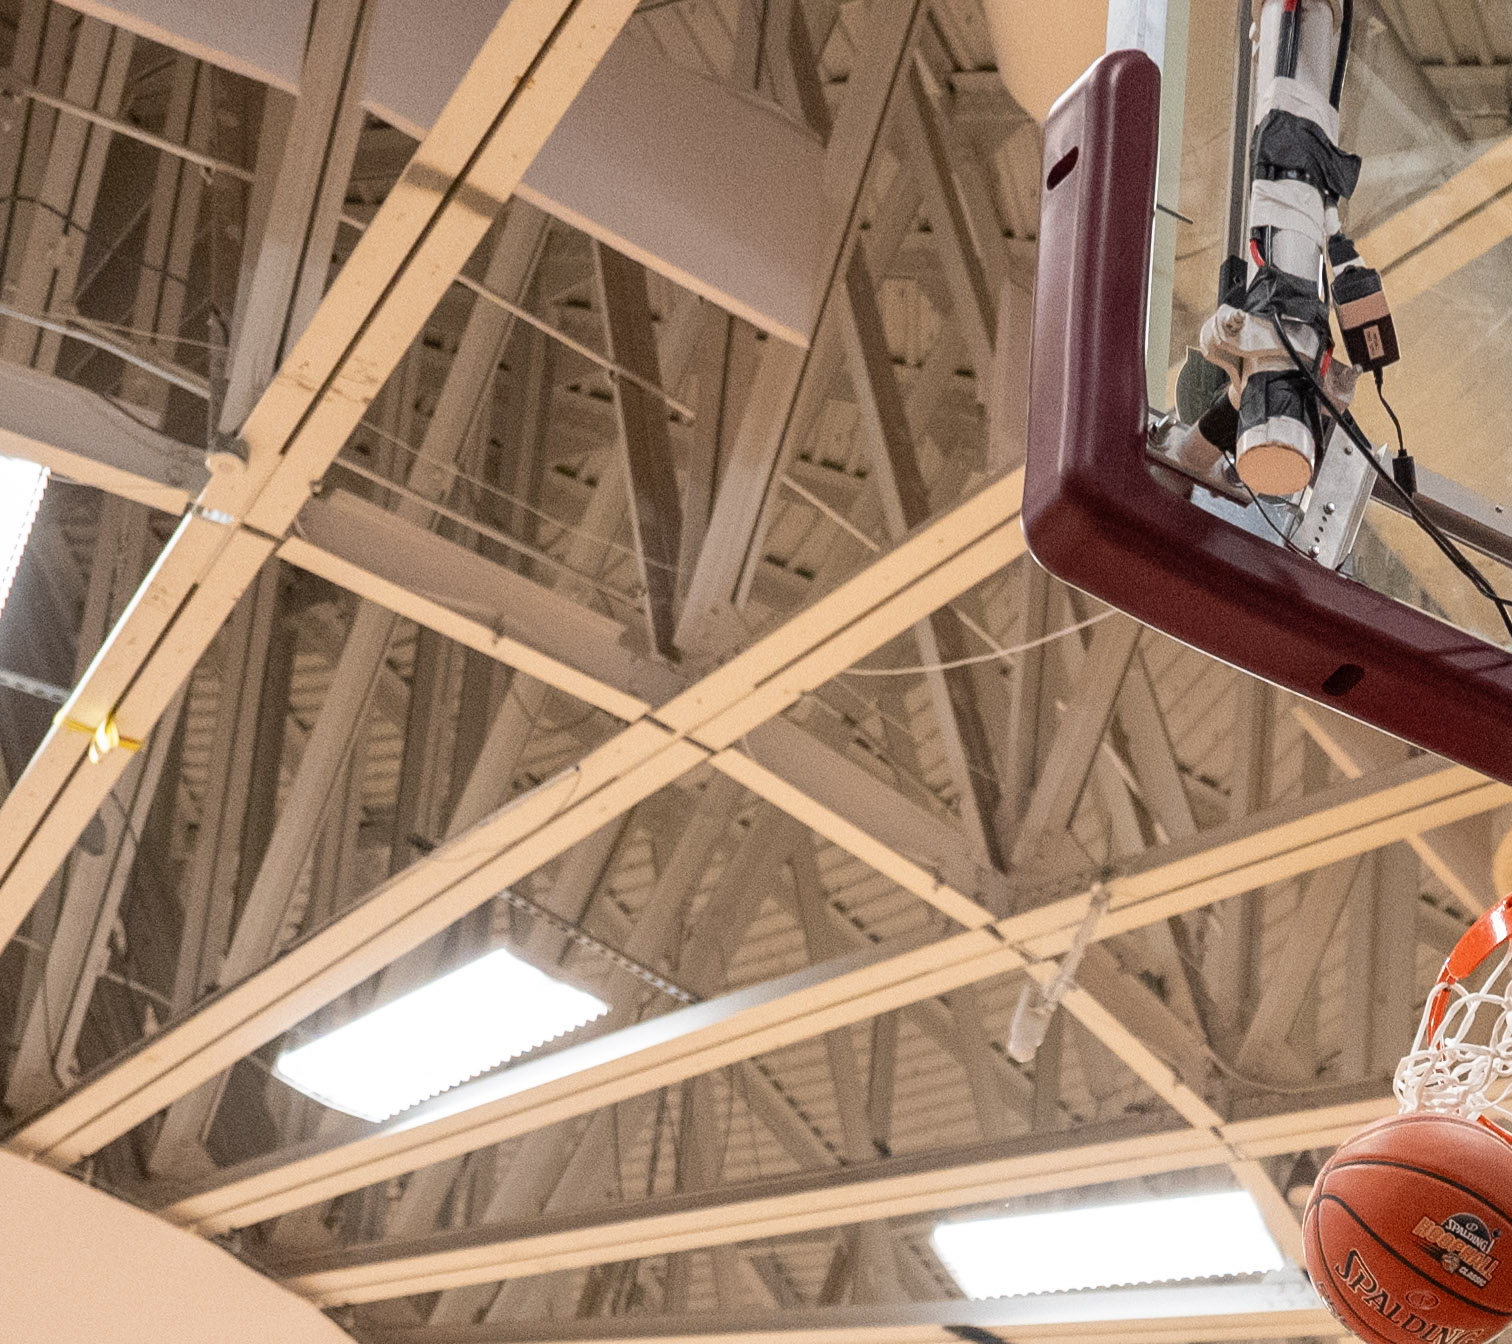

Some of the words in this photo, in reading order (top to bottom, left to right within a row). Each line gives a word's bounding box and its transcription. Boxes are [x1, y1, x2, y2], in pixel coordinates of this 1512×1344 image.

[1411, 1216, 1501, 1281] HOOPHALL
[1445, 1218, 1488, 1254] SPALDING
[1458, 1266, 1487, 1287] CLASSIC
